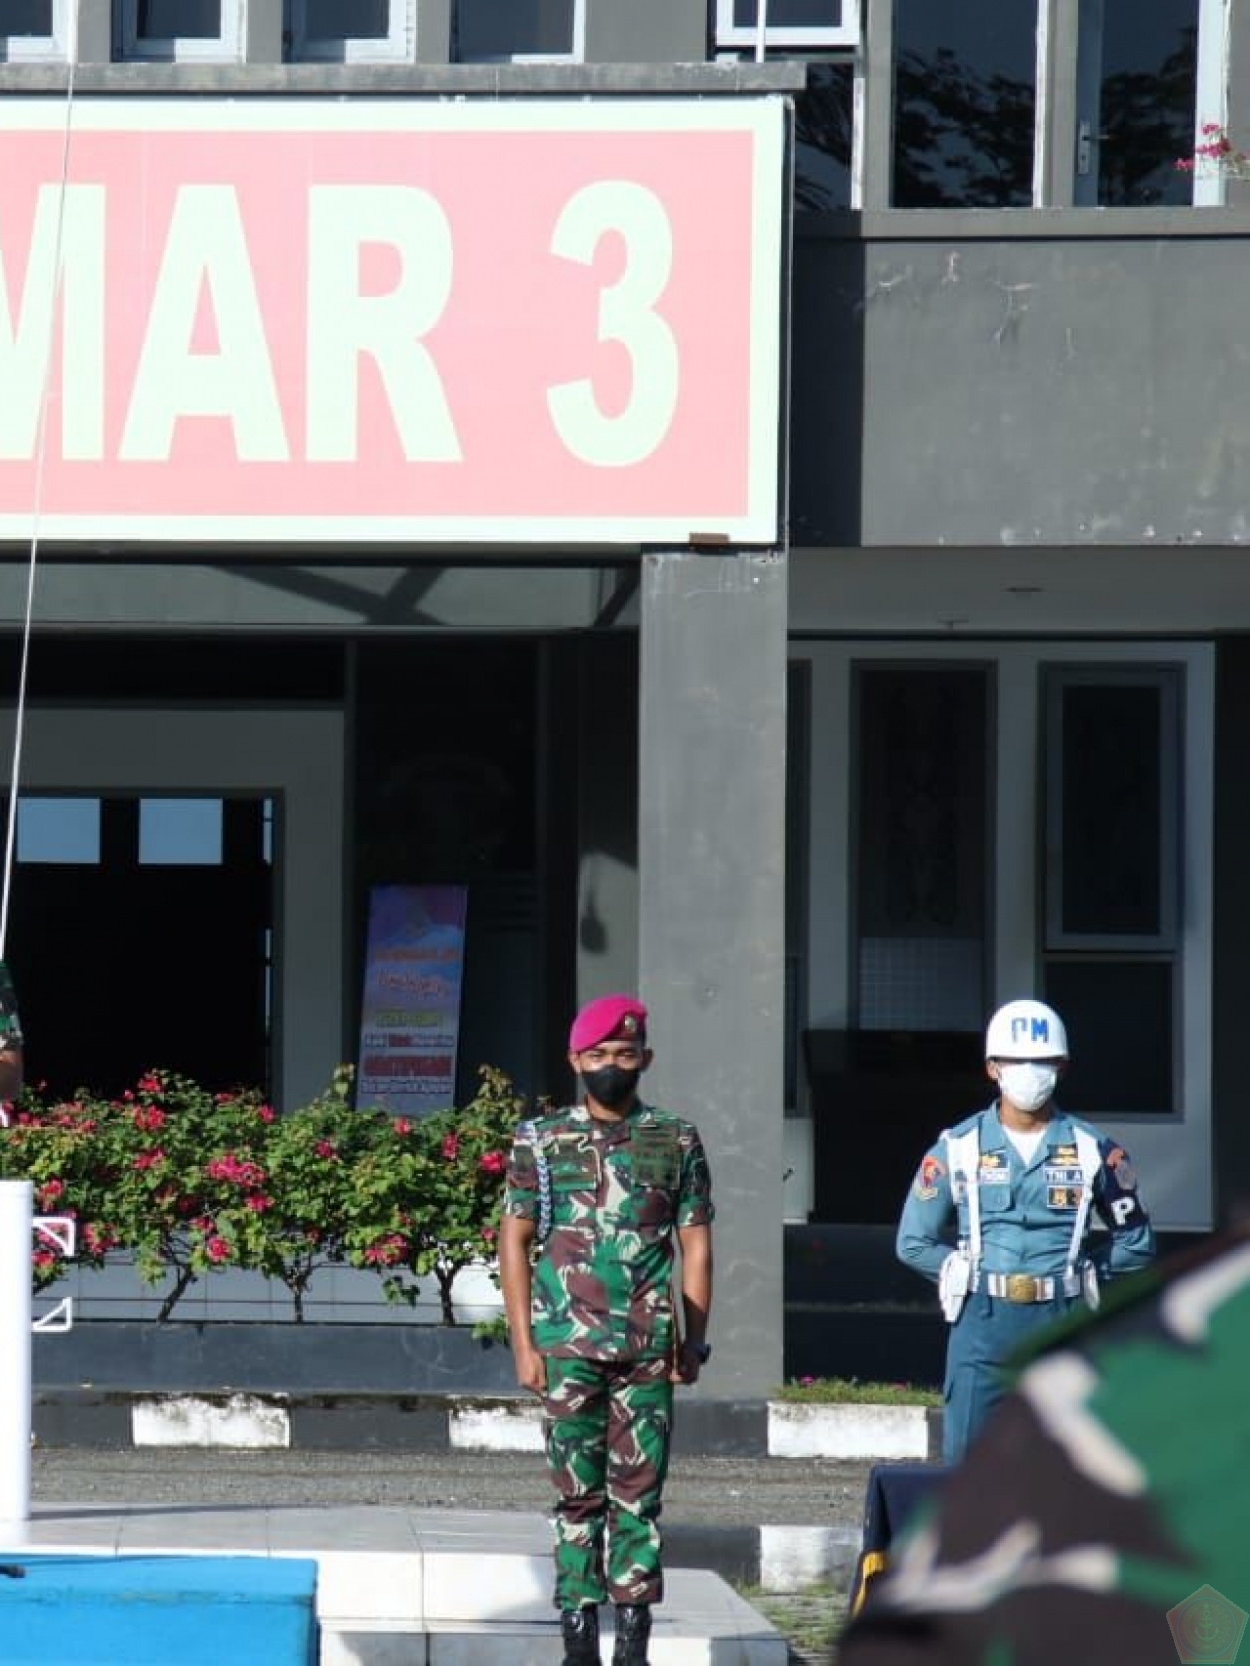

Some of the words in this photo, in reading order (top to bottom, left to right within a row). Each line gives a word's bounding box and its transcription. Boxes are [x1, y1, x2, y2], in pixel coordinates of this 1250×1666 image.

[546, 180, 680, 467] 3
[1011, 1017, 1049, 1043] PM
[1111, 1196, 1135, 1225] P
